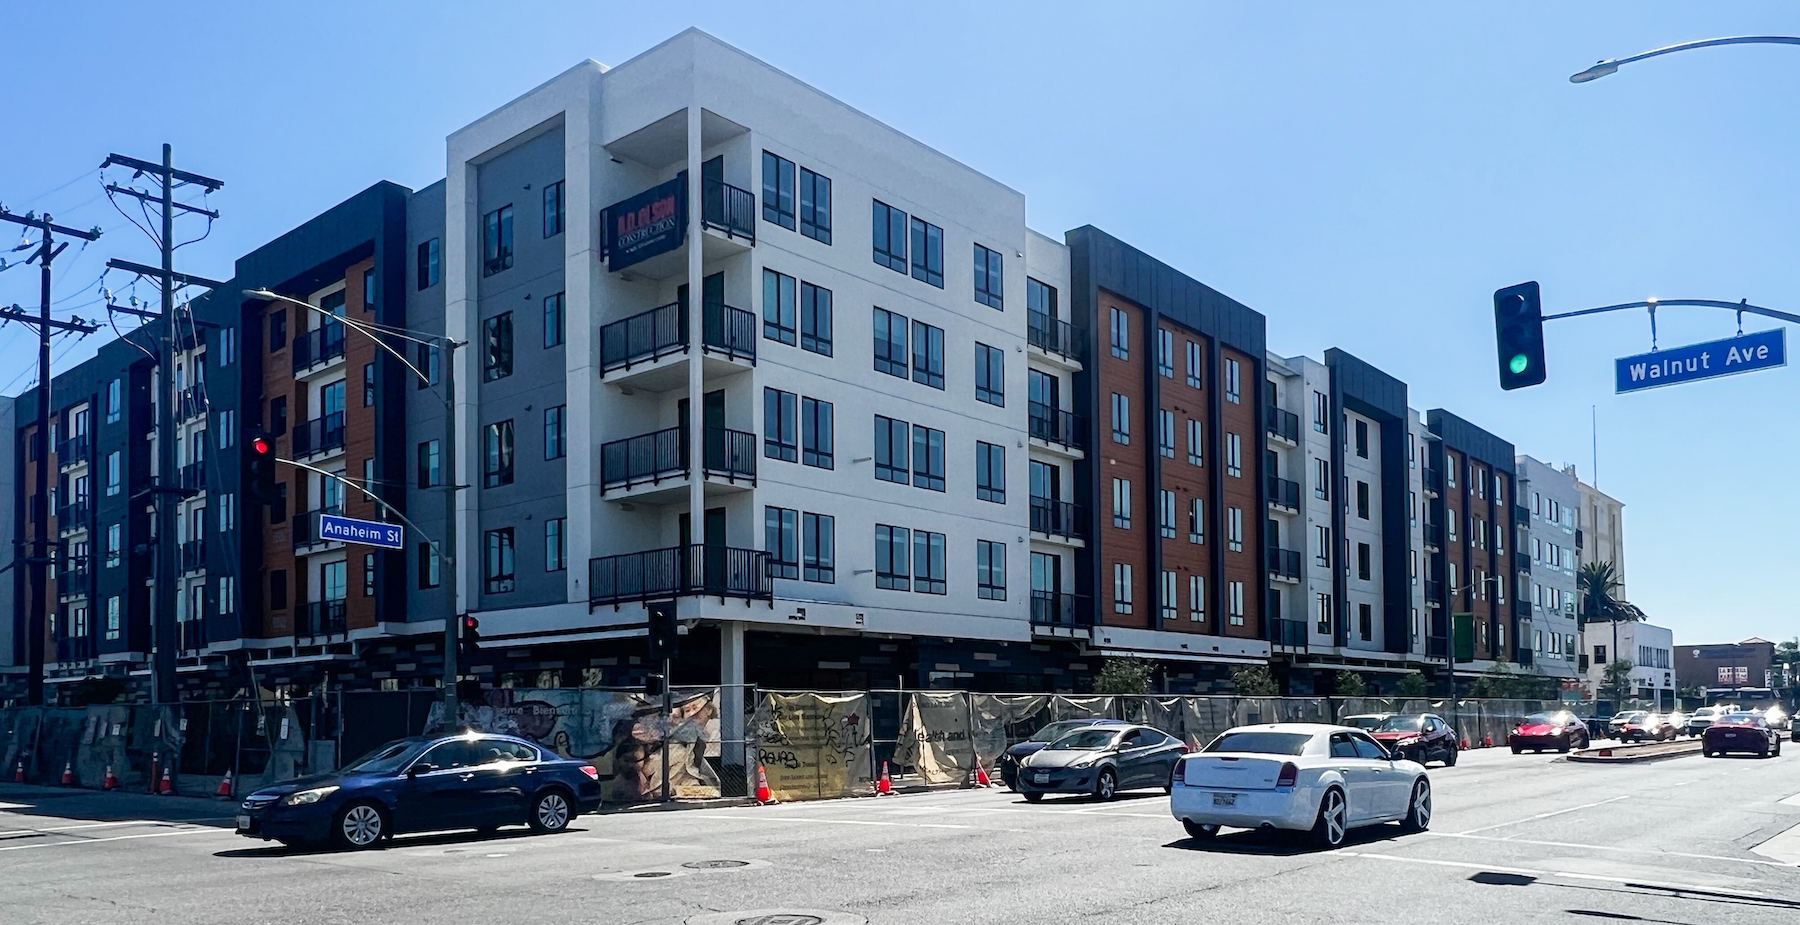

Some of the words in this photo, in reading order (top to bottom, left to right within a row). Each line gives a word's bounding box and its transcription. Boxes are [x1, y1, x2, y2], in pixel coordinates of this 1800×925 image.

[618, 217, 676, 248] CONSTRUCTION
[1629, 352, 1710, 382] Walnut
[1725, 344, 1769, 366] Ave
[324, 522, 381, 540] Anaheim
[387, 529, 399, 543] St
[946, 729, 965, 741] and
